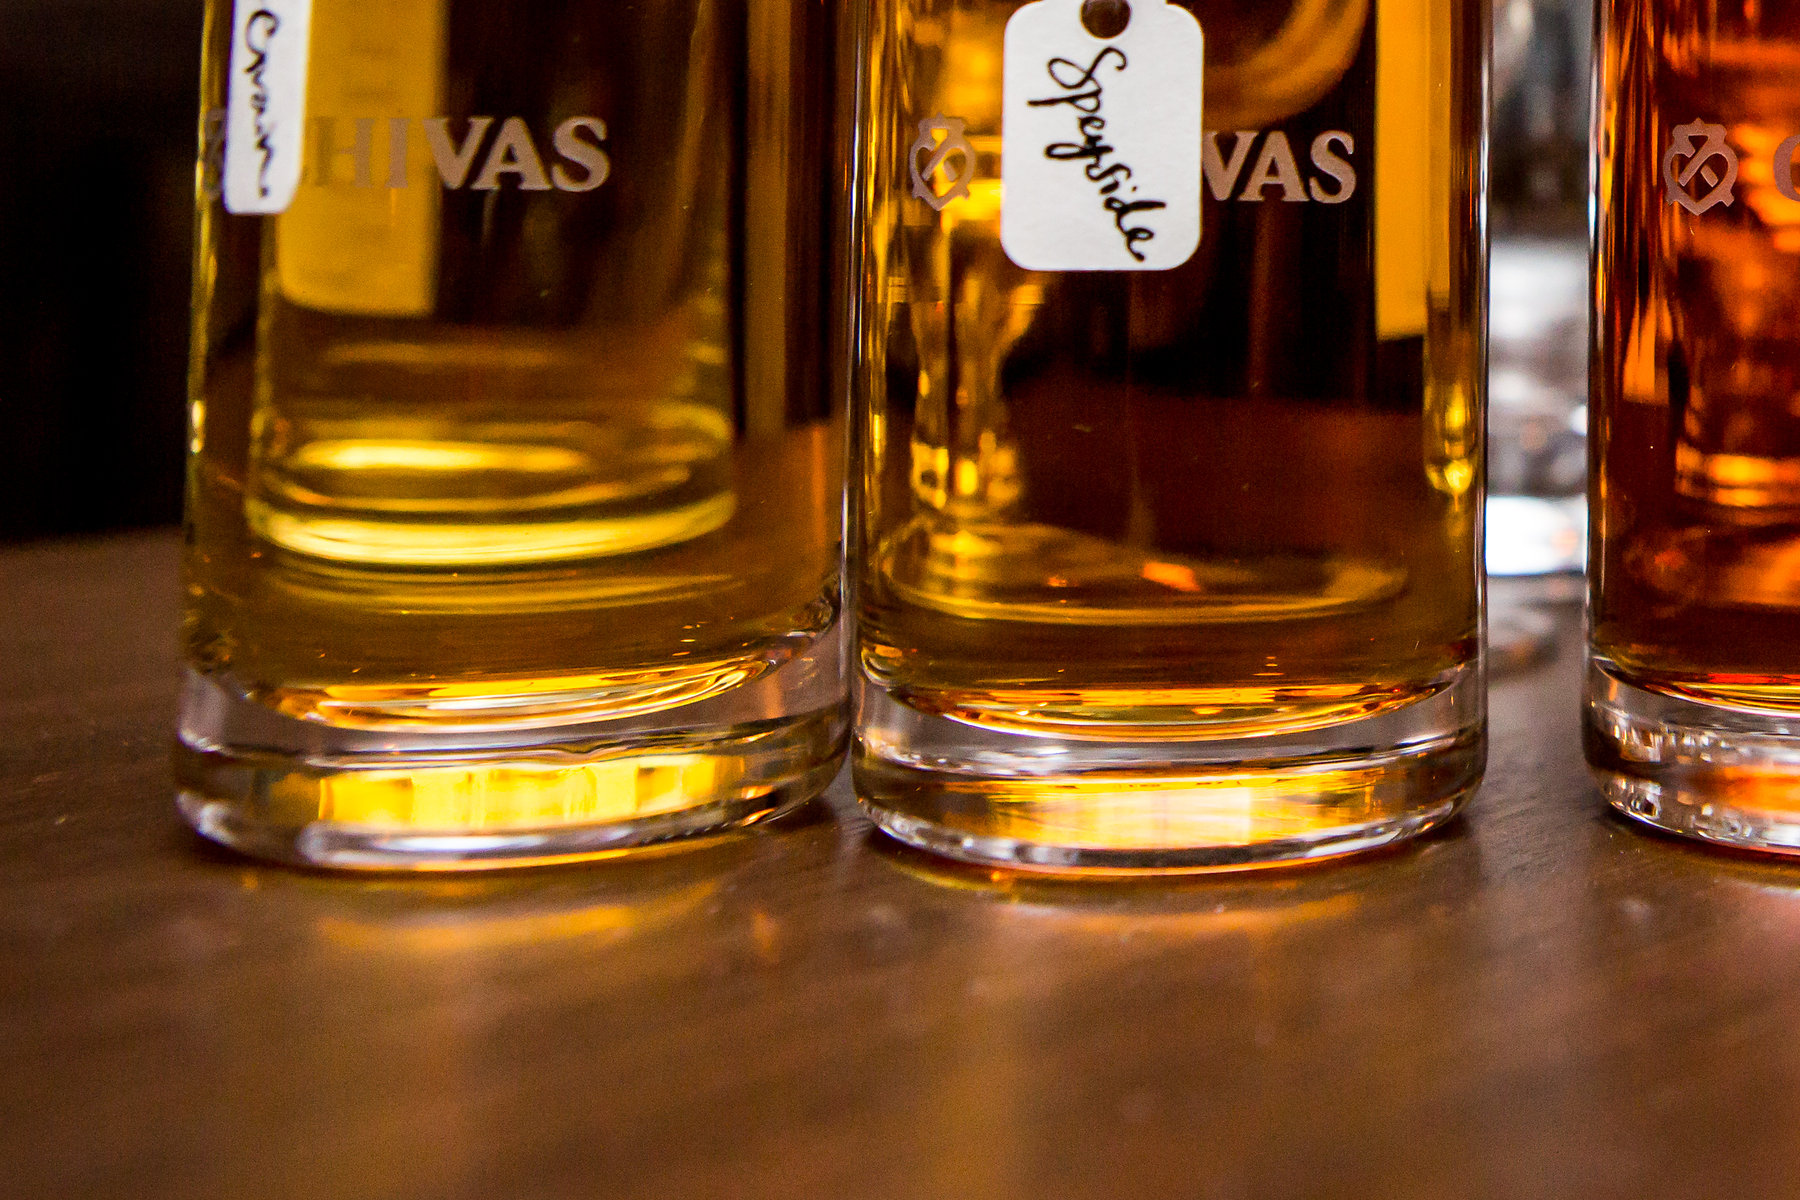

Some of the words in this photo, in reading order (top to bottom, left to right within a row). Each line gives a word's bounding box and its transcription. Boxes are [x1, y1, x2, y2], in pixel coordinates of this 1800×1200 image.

[302, 115, 611, 192] HIVAS
[1026, 46, 1167, 263] Speyside
[1201, 130, 1357, 204] VAS
